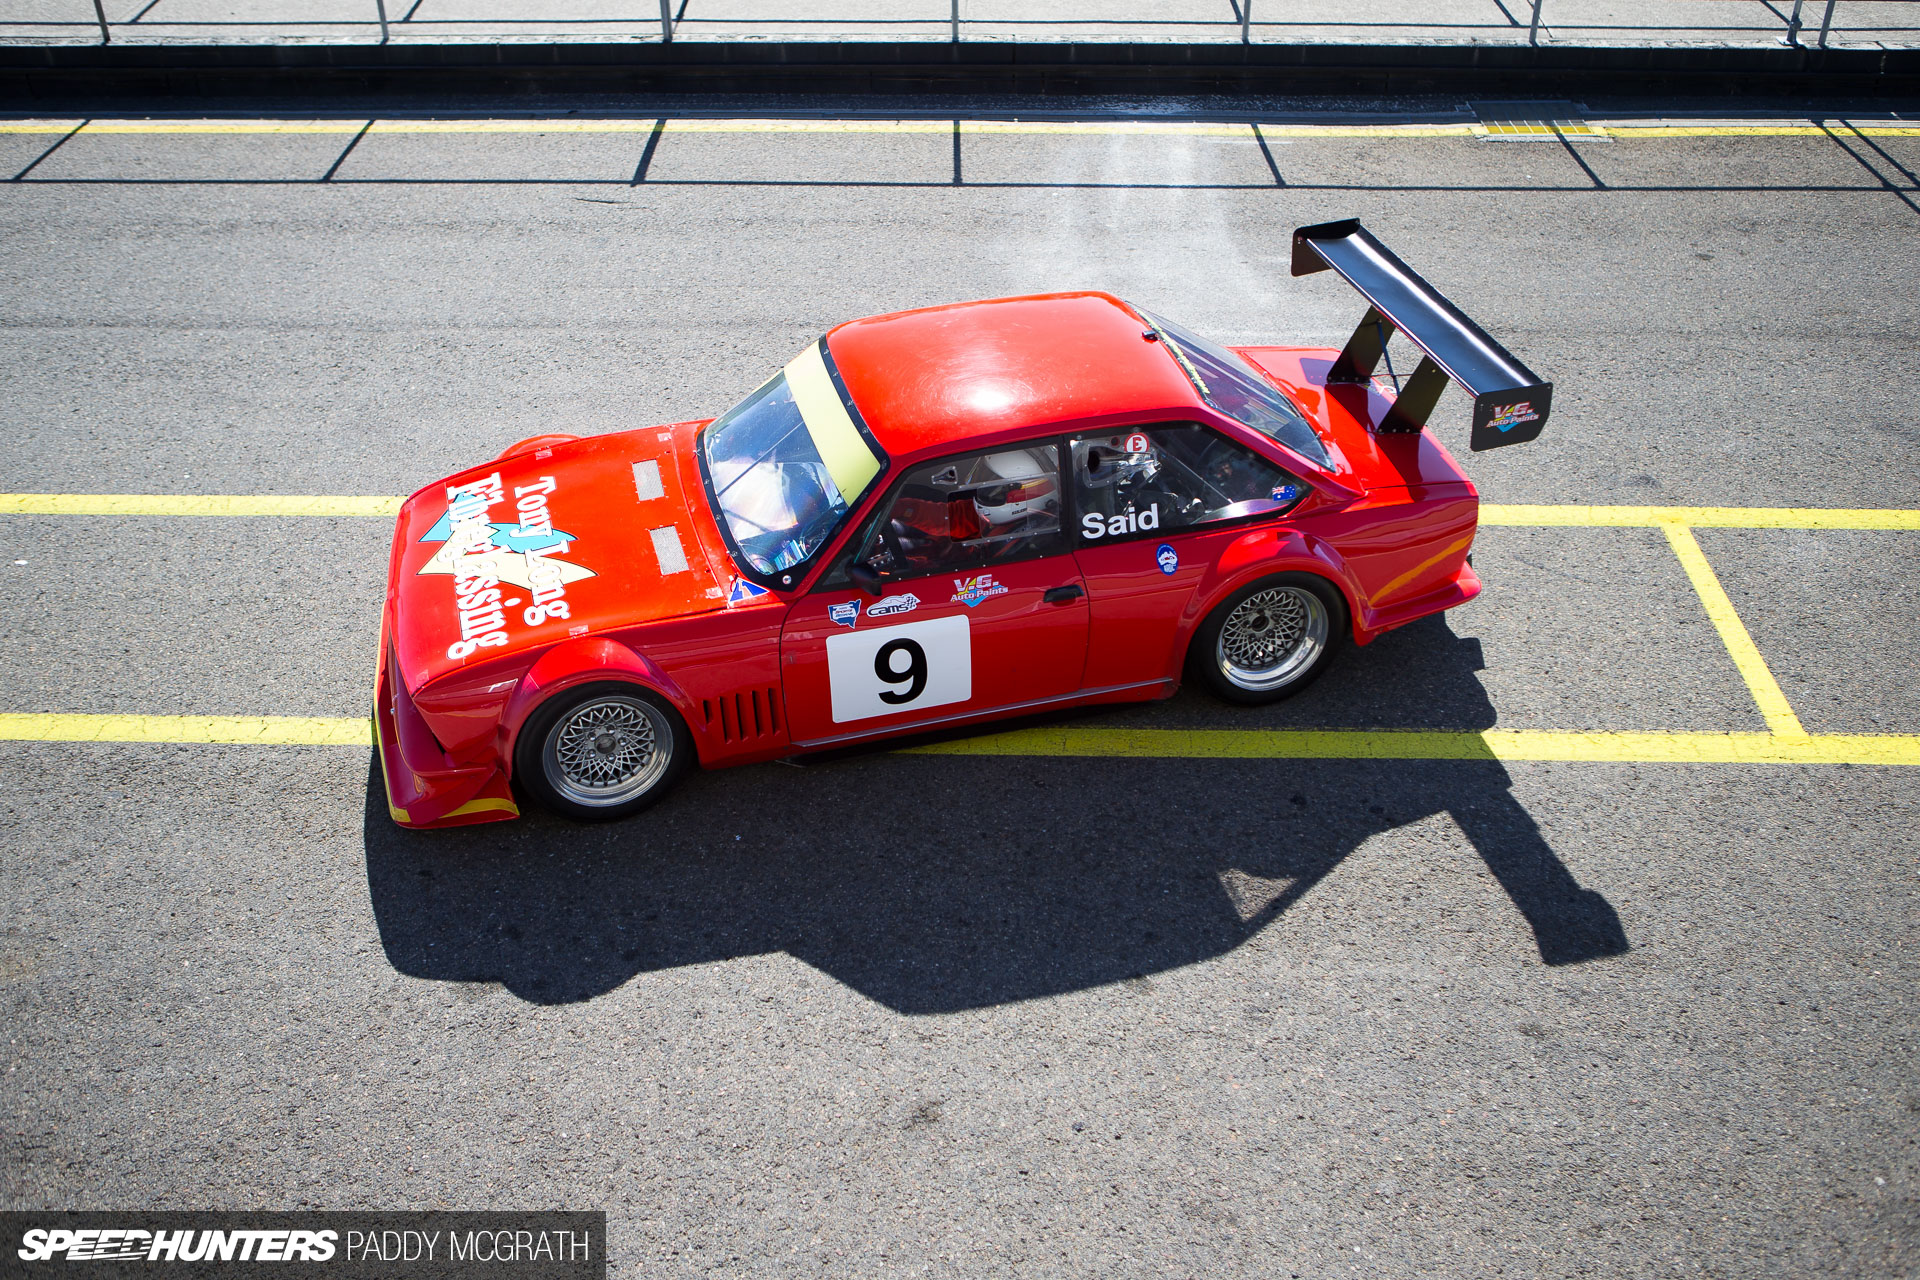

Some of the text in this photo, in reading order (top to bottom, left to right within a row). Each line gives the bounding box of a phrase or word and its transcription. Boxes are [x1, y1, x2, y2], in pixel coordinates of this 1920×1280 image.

[1485, 413, 1540, 428] Auto Paints
[1132, 436, 1143, 452] E
[1081, 503, 1160, 540] Said
[509, 476, 571, 627] Tony Long
[435, 472, 522, 661] Fibreglassing
[953, 574, 999, 592] V.G.
[950, 587, 1009, 602] Auto Paints
[868, 604, 909, 616] cams
[874, 637, 928, 705] 9
